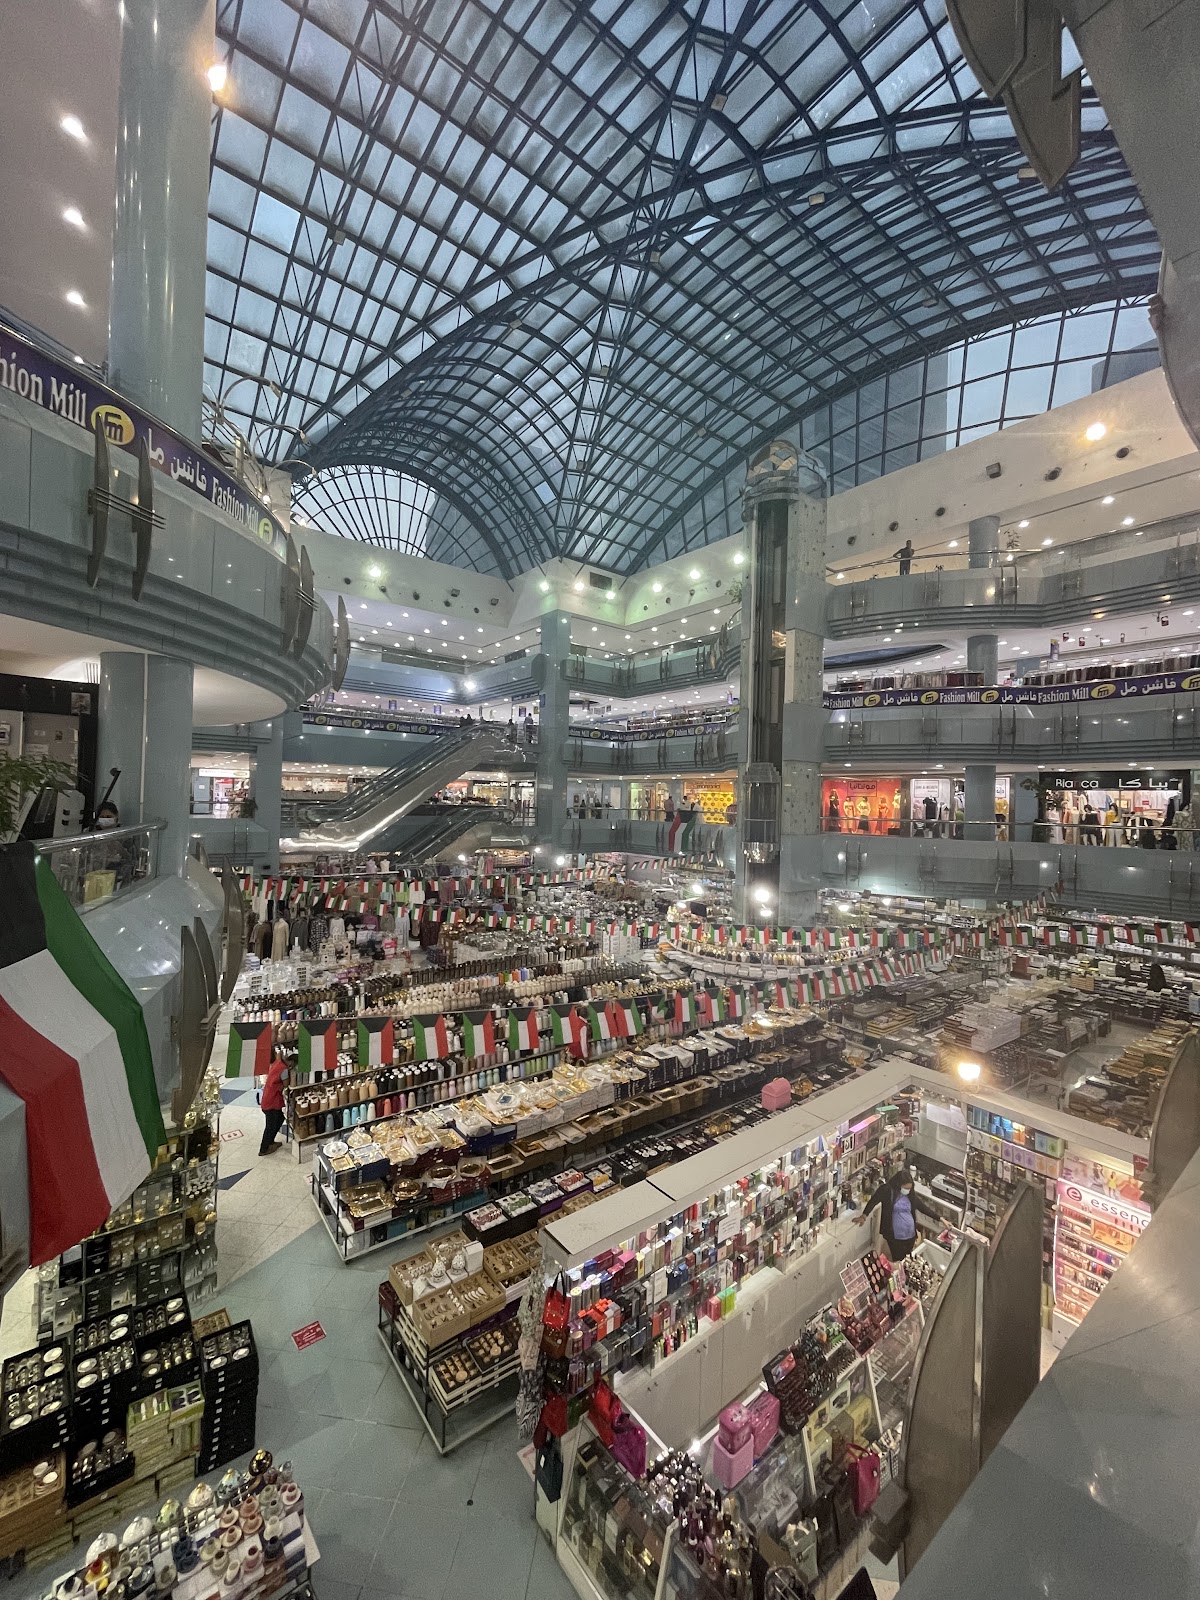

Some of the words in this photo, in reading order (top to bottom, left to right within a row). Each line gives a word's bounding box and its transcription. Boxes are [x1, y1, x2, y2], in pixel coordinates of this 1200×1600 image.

[49, 376, 87, 428] Mill
[170, 456, 207, 492] فاشن
[212, 476, 245, 524] Fashion
[246, 503, 259, 535] Mill
[1120, 681, 1138, 696] مل
[1141, 677, 1177, 695] فاشن
[829, 697, 851, 709] Fashion
[852, 695, 864, 708] Mill
[883, 693, 895, 706] مل
[896, 692, 919, 705] فاشن
[939, 690, 966, 704] Fashion
[966, 690, 980, 703] Mill
[1001, 690, 1013, 704] مل
[1016, 690, 1037, 704] فاشن
[1038, 689, 1070, 704] Fashion
[1071, 686, 1090, 701] Mill
